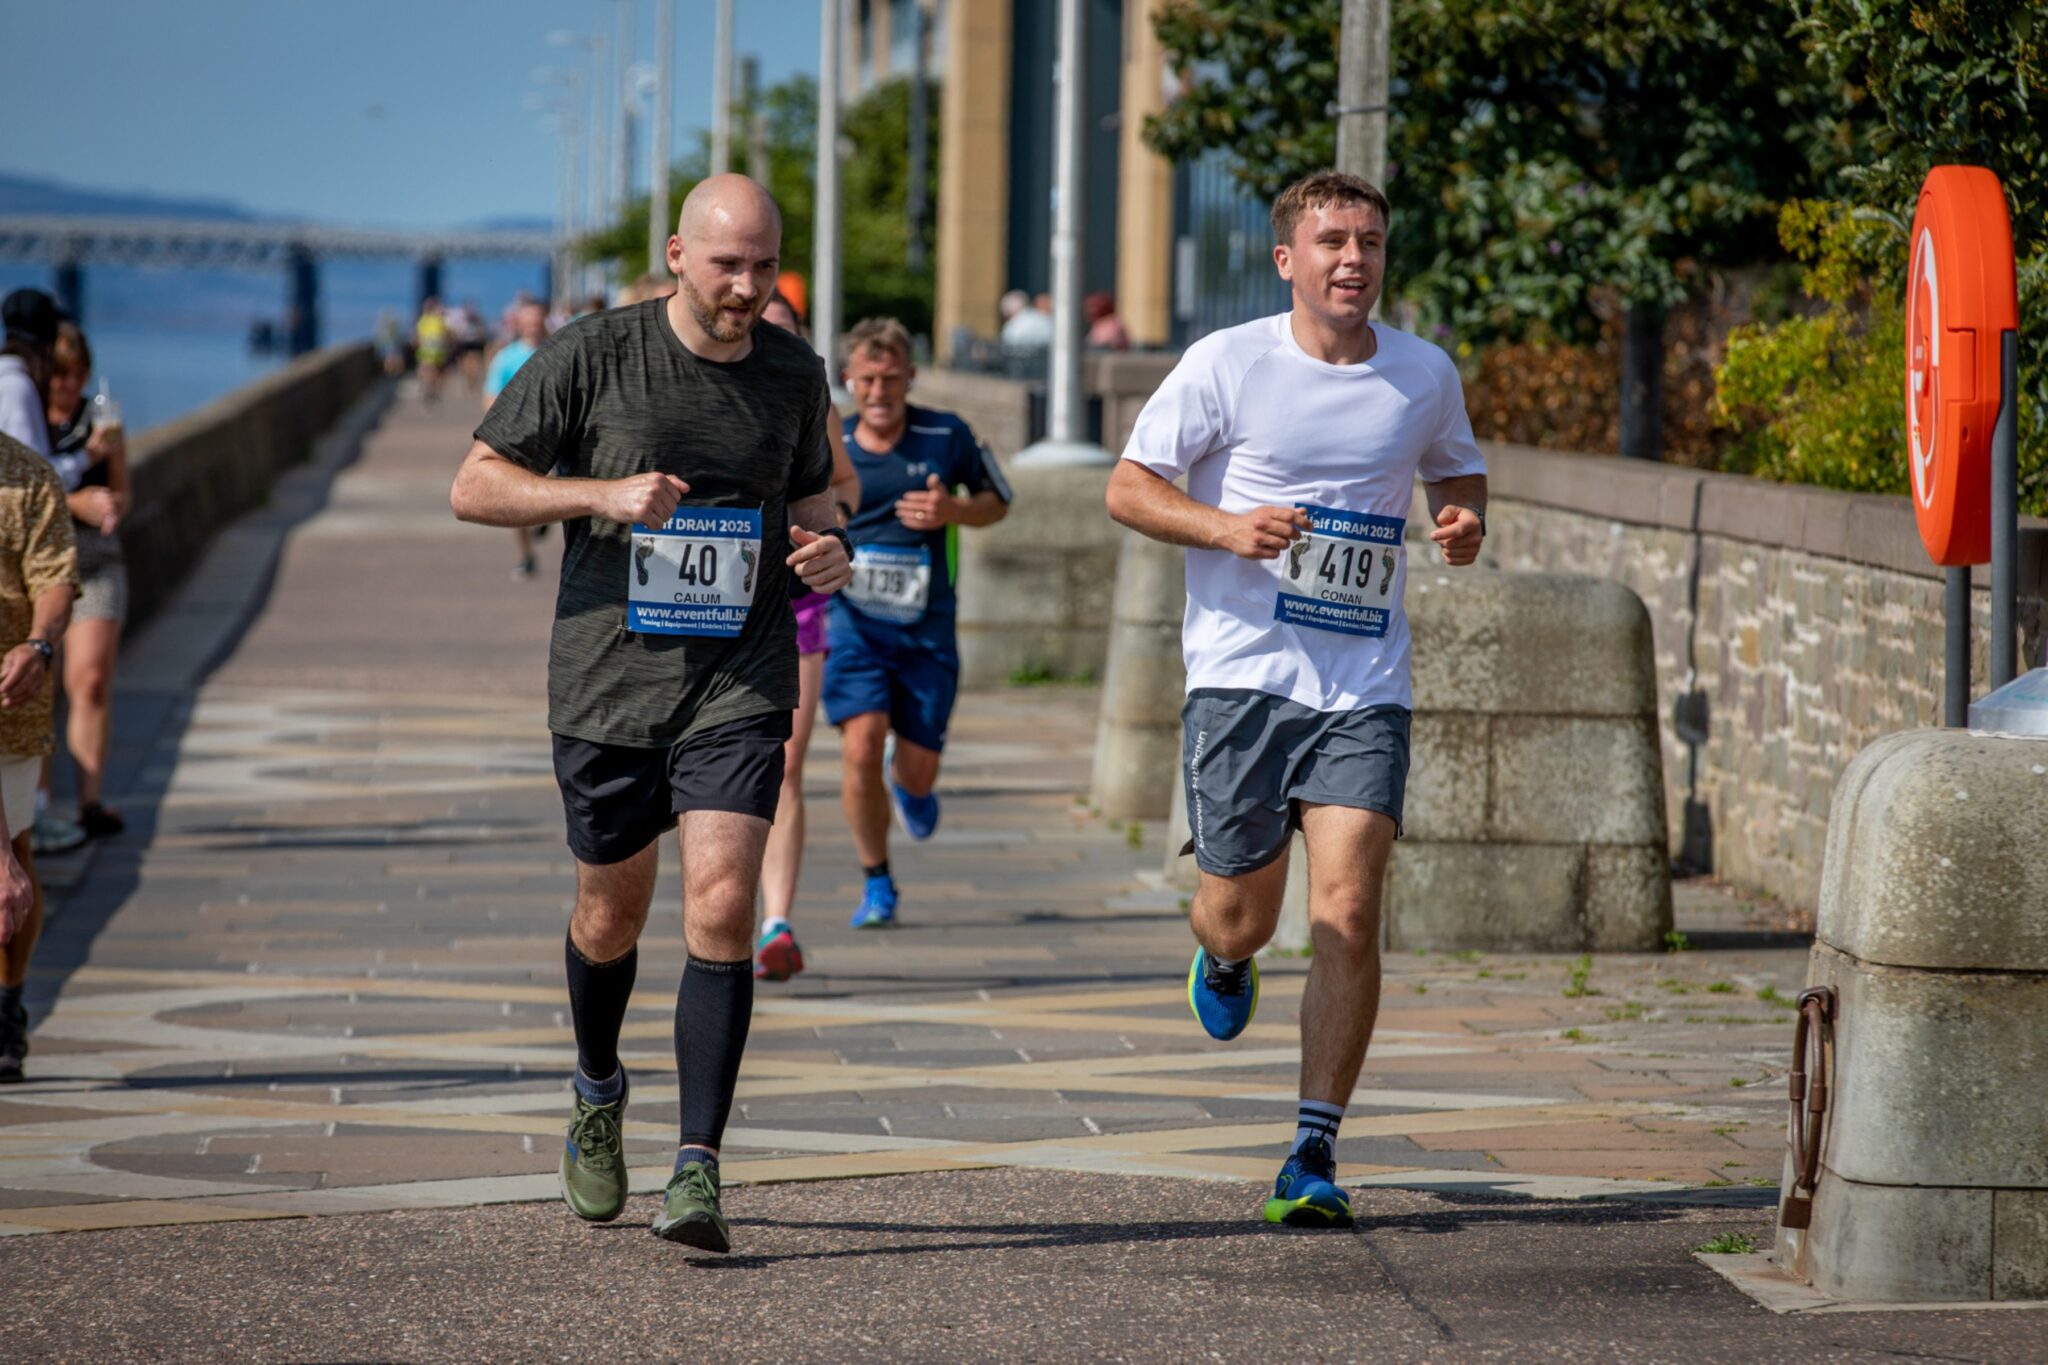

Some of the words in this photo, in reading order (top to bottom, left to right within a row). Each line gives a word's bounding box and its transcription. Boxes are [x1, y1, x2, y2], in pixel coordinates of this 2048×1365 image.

[675, 518, 717, 532] DRAM
[719, 519, 752, 533] 2025
[1332, 519, 1369, 536] DRAM
[1370, 525, 1396, 539] 2025
[678, 543, 718, 587] 40
[1318, 543, 1373, 589] 419
[673, 592, 721, 604] CALUM
[1321, 589, 1362, 605] CONAN
[1284, 599, 1384, 623] www.eventfull.biz
[1193, 789, 1205, 848] ARMOUR
